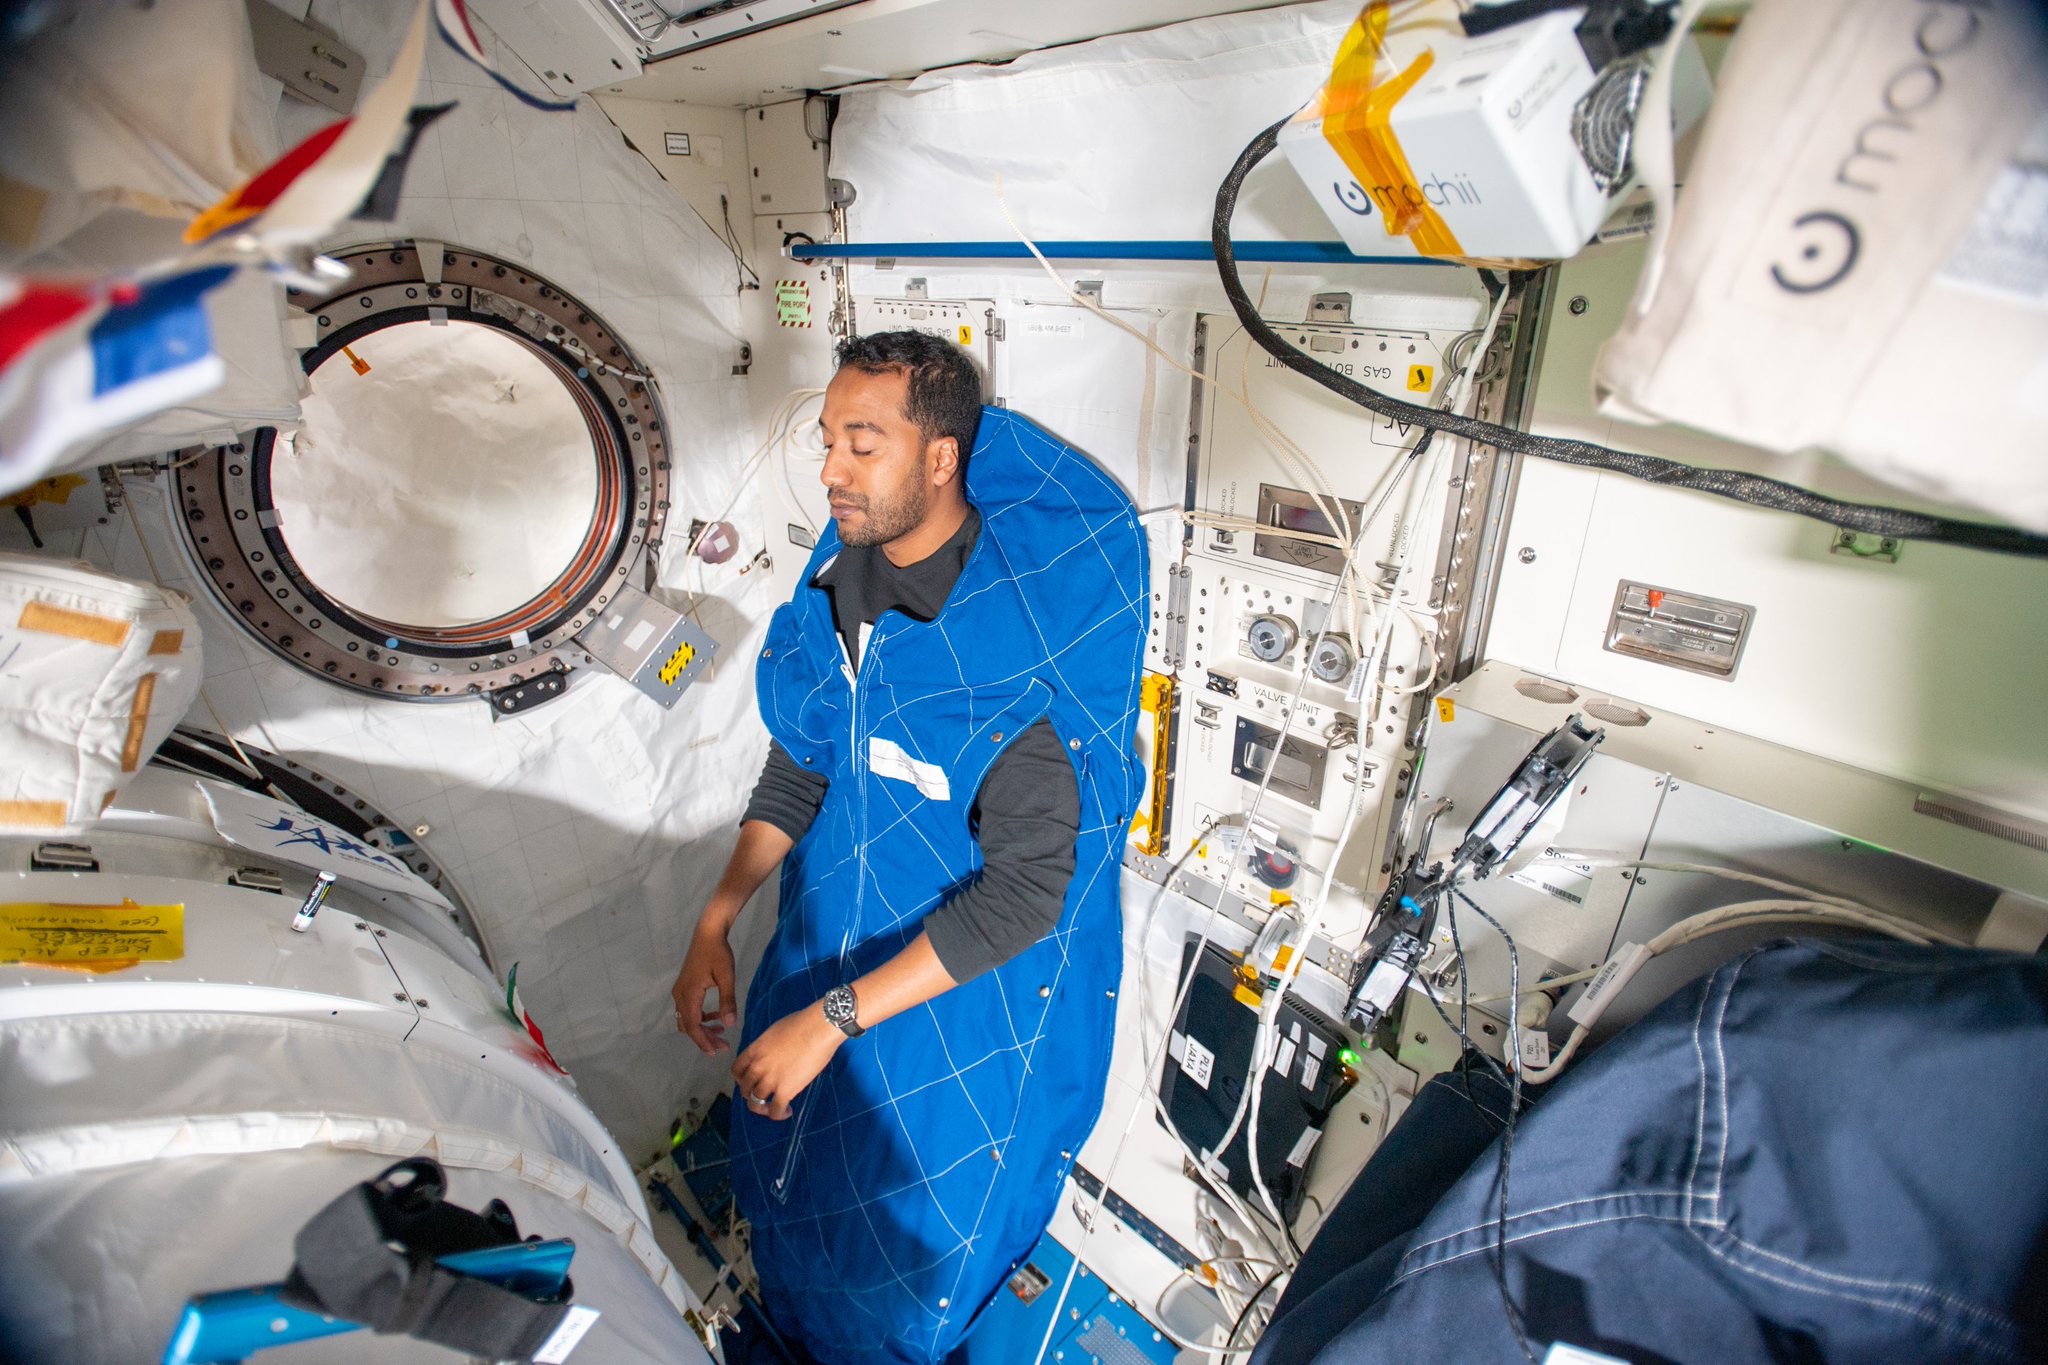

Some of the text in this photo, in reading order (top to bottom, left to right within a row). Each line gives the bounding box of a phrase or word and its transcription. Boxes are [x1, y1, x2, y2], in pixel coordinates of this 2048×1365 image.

[1372, 172, 1482, 207] mochii
[792, 301, 806, 309] PORT
[937, 327, 951, 337] GAS
[1363, 363, 1392, 379] GAS
[1384, 416, 1412, 438] Ar
[1400, 525, 1409, 555] LOCKED
[1254, 686, 1288, 705] VALVE
[6, 944, 150, 957] KEEP ALL
[1186, 1043, 1196, 1071] JAXA
